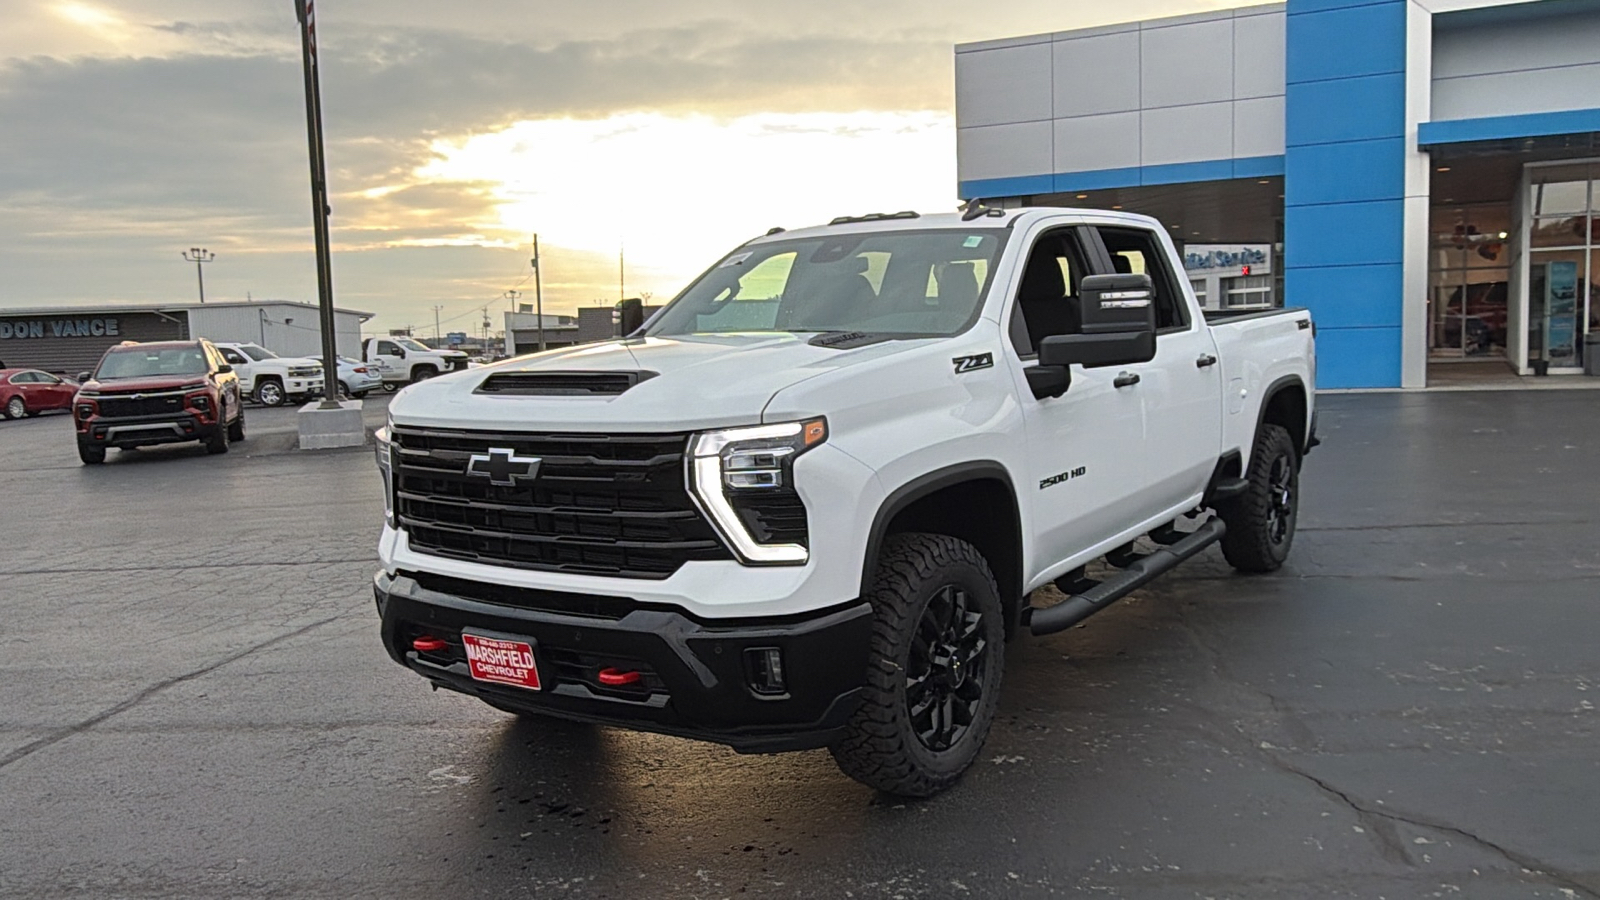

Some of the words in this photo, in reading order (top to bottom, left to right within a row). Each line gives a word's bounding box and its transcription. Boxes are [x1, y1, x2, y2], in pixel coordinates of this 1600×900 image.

[0, 321, 44, 339] DON
[51, 318, 119, 337] VANCE
[1039, 471, 1069, 490] 2500
[1071, 466, 1086, 479] HD
[465, 643, 534, 669] MARSHFIELD
[476, 662, 529, 679] CHEVROLET
